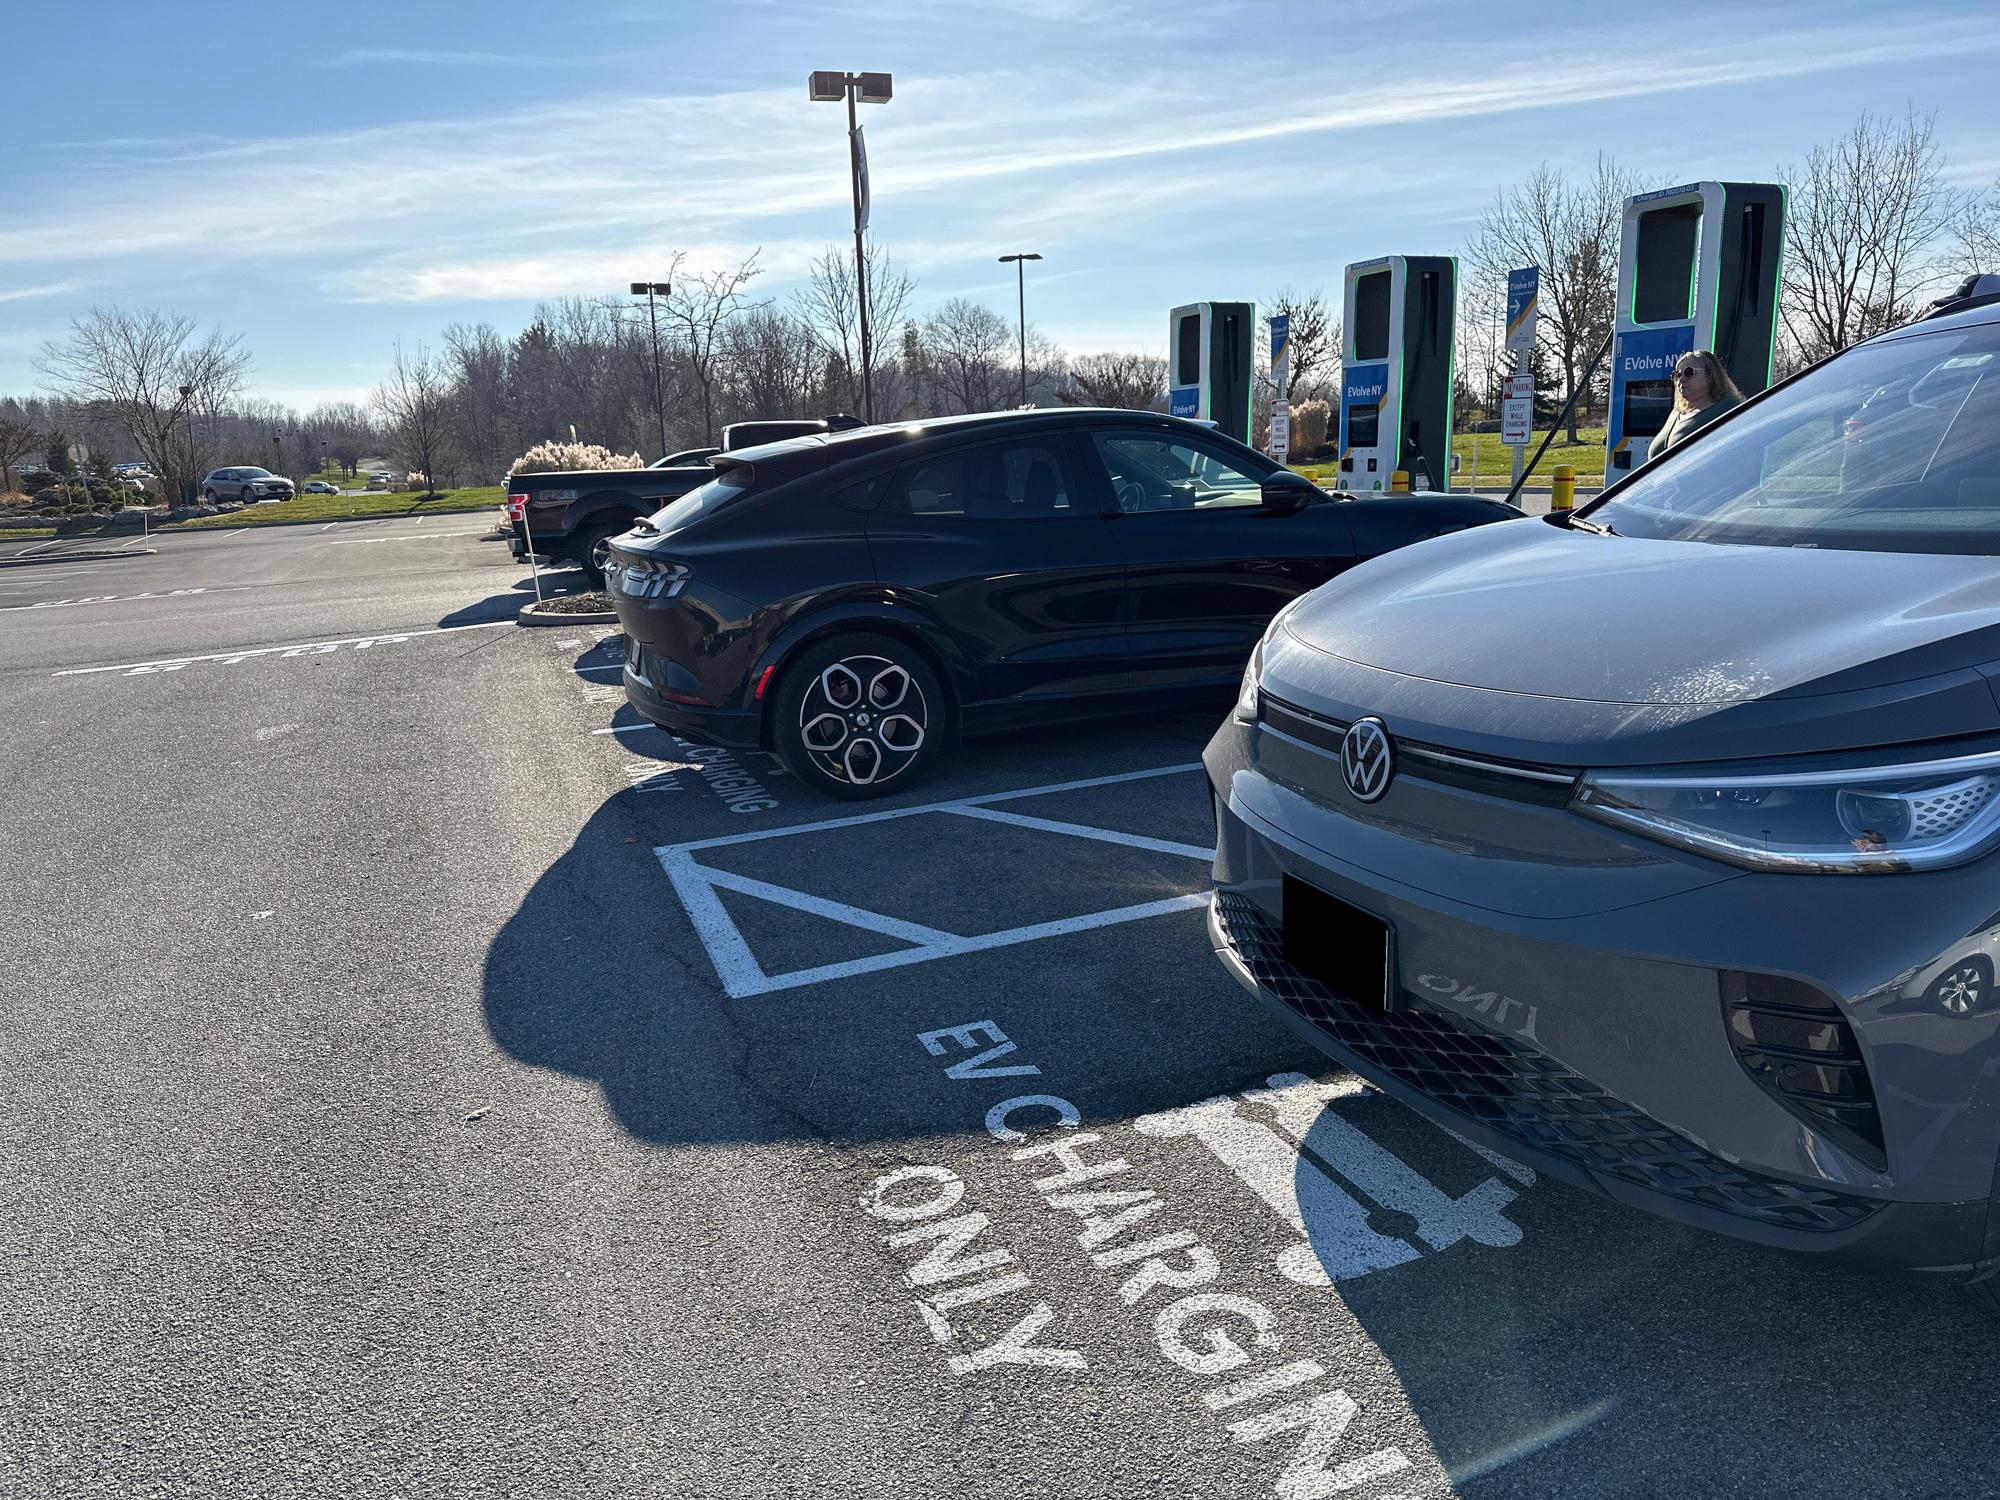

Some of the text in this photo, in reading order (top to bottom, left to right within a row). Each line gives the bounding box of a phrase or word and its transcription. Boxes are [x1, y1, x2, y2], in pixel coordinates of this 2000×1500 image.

[1636, 191, 1658, 202] Charger
[1527, 280, 1536, 288] NY
[1624, 355, 1663, 371] EVolve
[1347, 385, 1382, 397] EVolve NY
[1173, 405, 1196, 415] EVolve NY
[121, 635, 412, 677] STOP
[1341, 720, 1390, 800] VW
[685, 748, 780, 813] CHARGING
[858, 1164, 1089, 1376] ONLY
[916, 1019, 1426, 1500] EV CHARGIN
